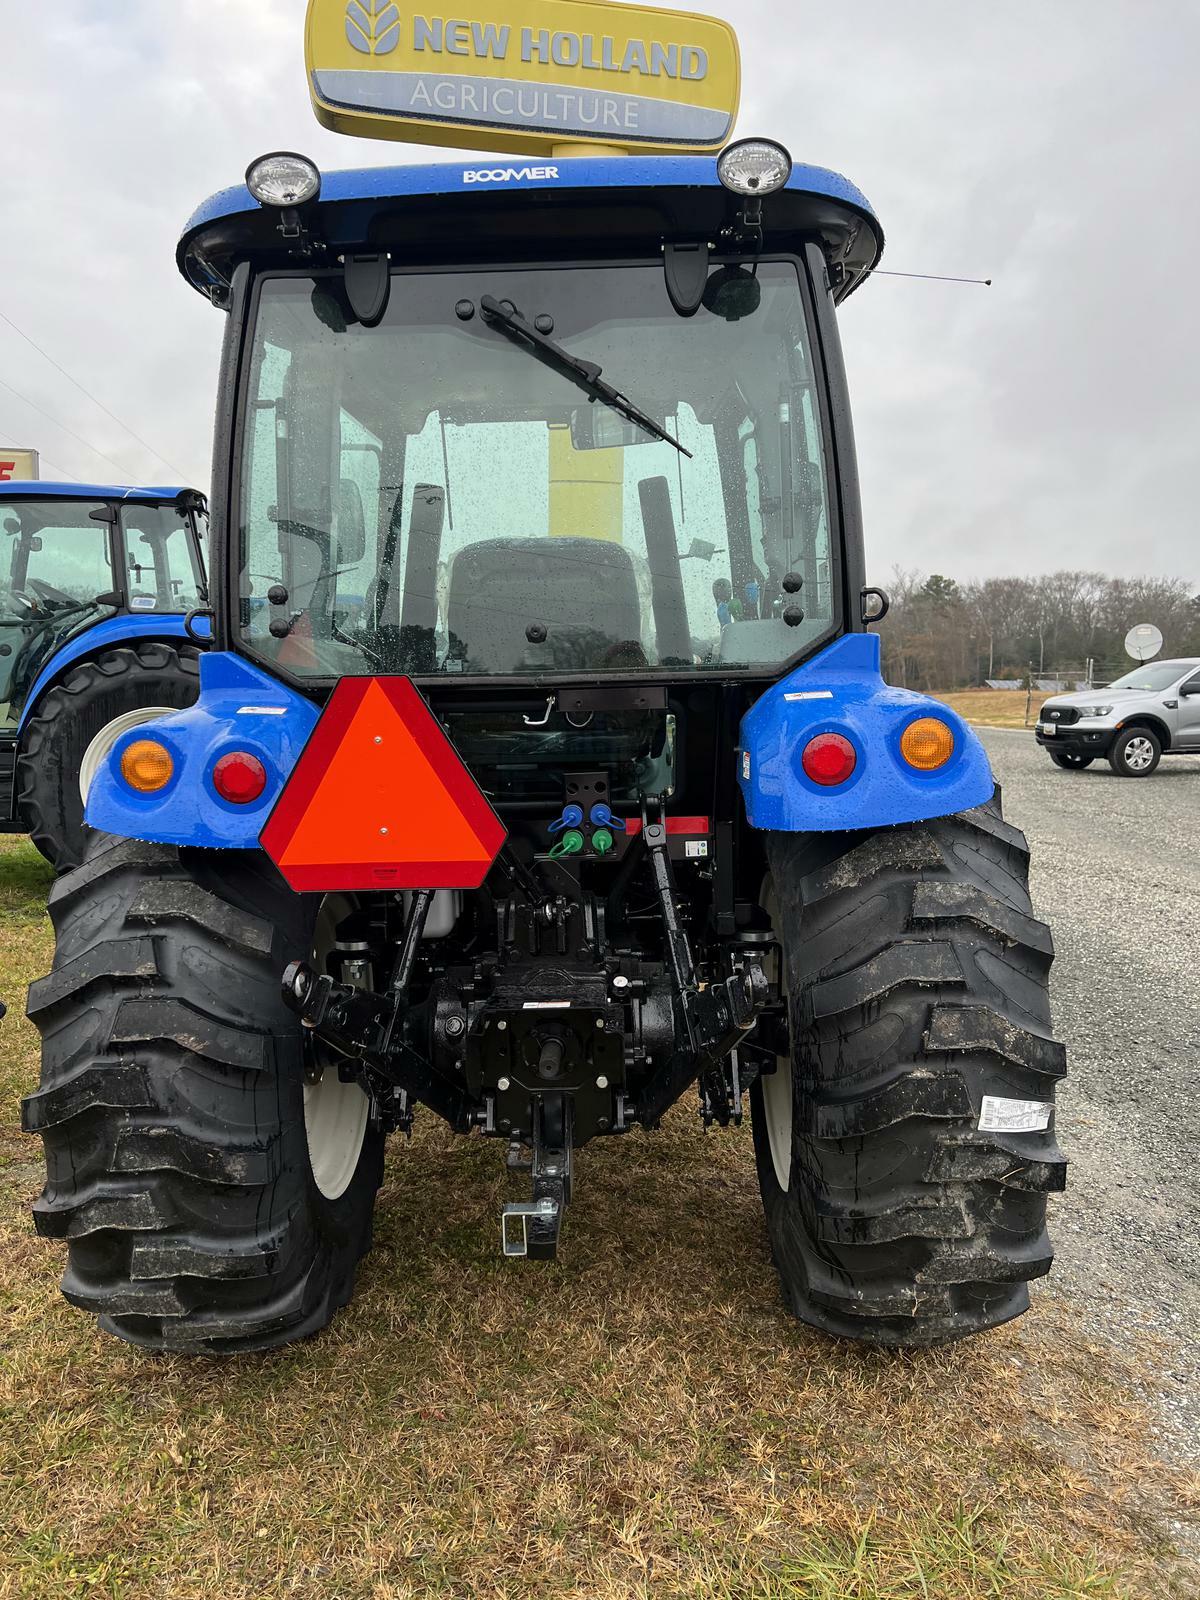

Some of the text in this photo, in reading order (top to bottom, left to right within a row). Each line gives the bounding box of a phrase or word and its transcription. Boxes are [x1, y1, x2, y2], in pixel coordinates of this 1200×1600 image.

[413, 15, 709, 81] NEW HOLLAND
[409, 79, 640, 129] AGRICULTURE
[463, 166, 560, 184] BOOMER
